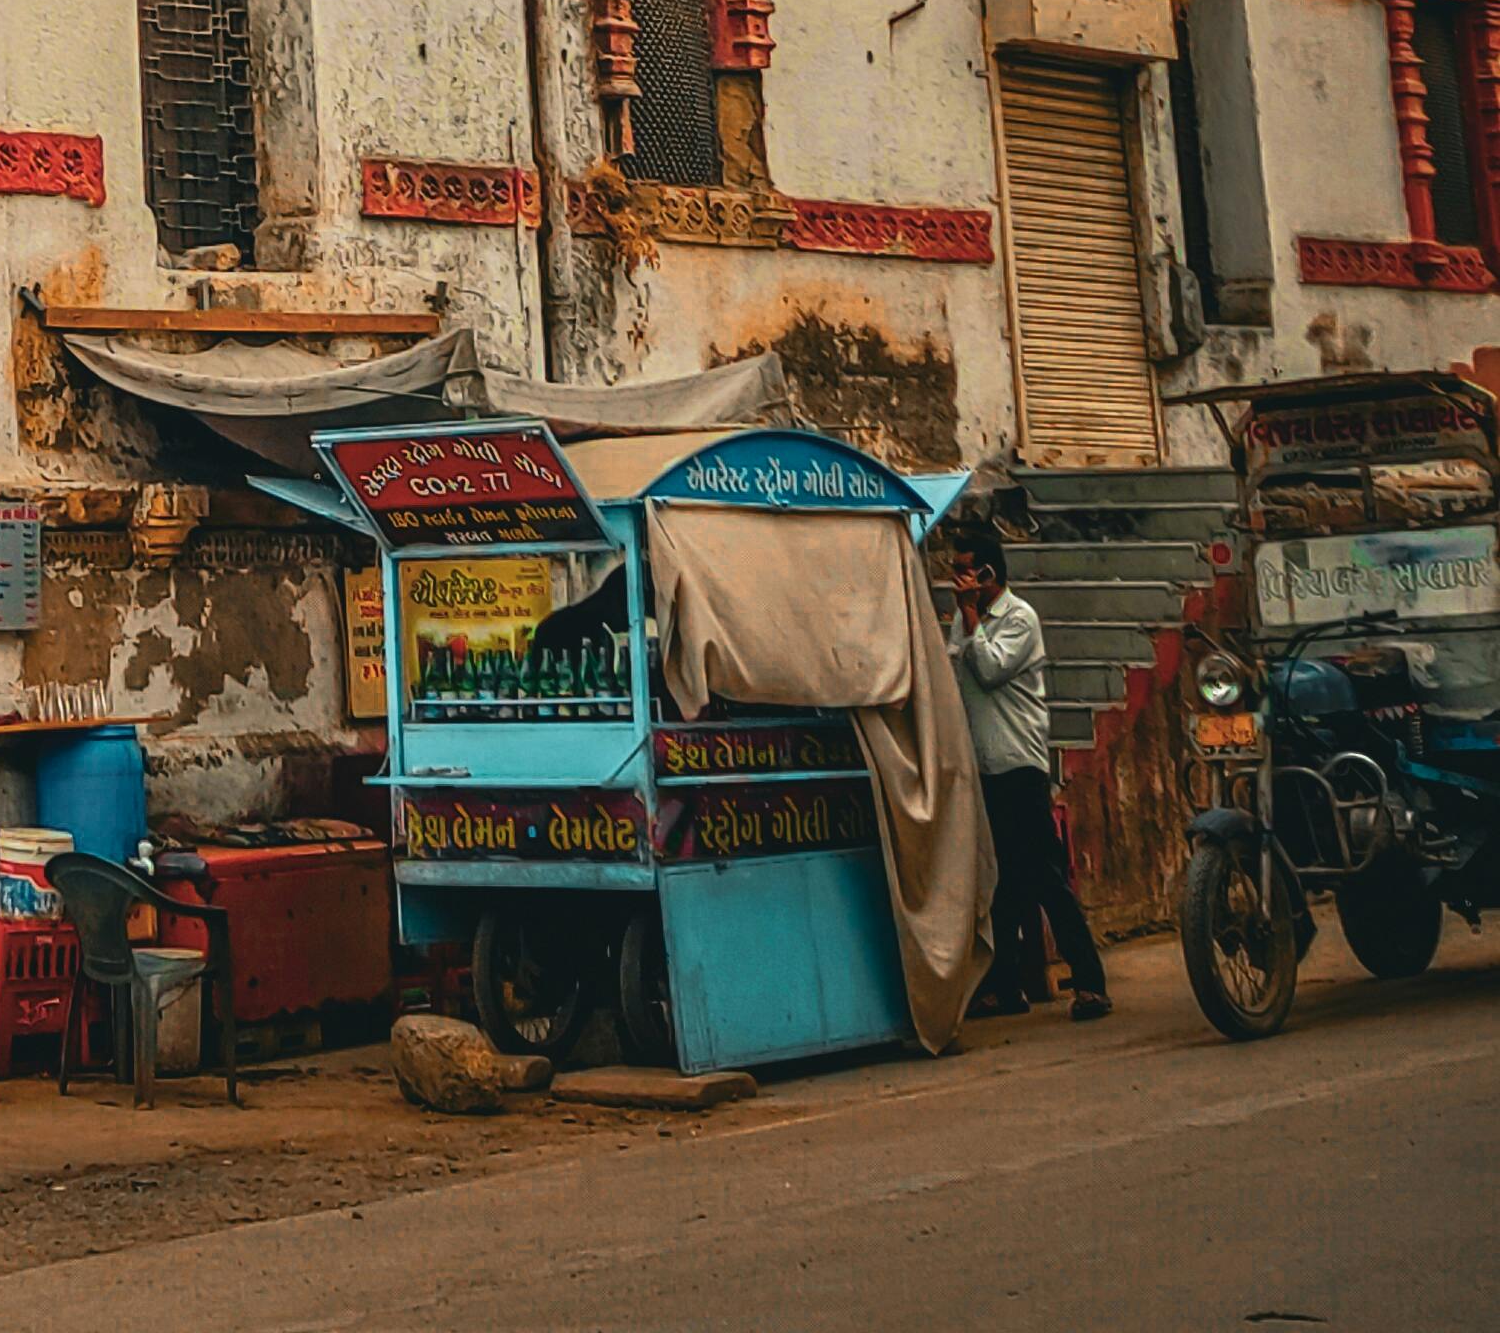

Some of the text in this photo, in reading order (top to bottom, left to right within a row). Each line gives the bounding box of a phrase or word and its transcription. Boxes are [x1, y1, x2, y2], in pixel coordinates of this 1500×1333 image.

[686, 455, 749, 493] એવરેસ્ટ
[803, 458, 844, 497] ગોલી
[848, 463, 885, 499] સોડા
[452, 802, 516, 849] લેમન
[548, 803, 637, 852] લેમલેટ
[771, 795, 831, 845] ગોલી
